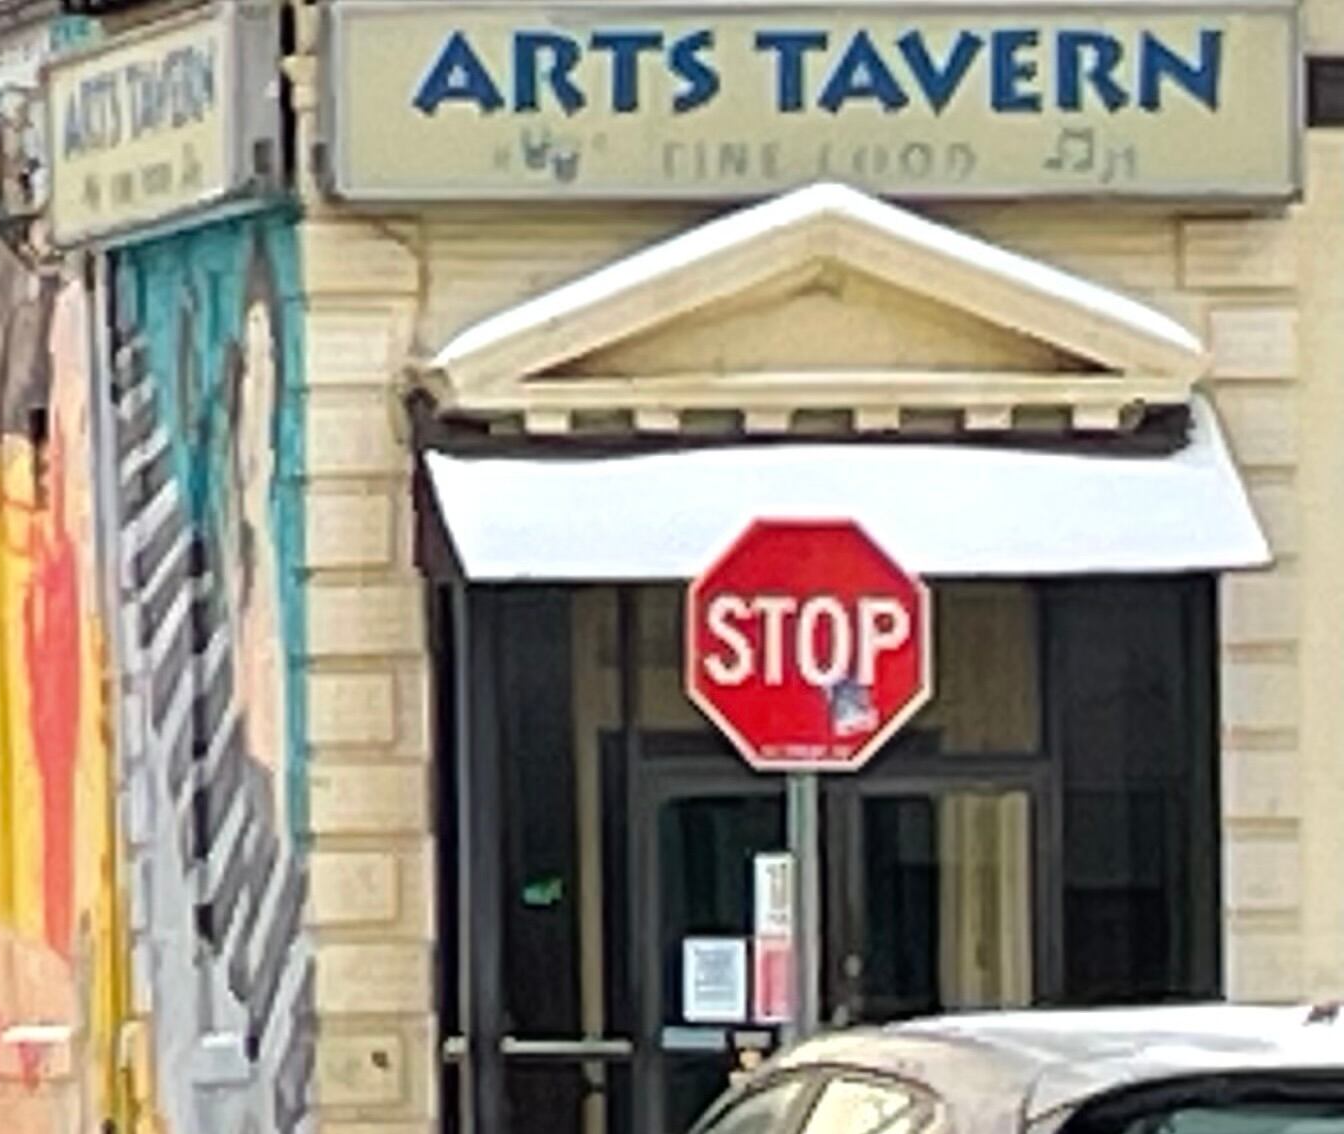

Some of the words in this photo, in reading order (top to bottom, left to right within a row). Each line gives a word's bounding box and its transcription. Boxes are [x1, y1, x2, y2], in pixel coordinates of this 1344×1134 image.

[411, 28, 721, 118] ARTS
[754, 28, 1224, 117] TAVERN
[702, 593, 912, 687] STOP
